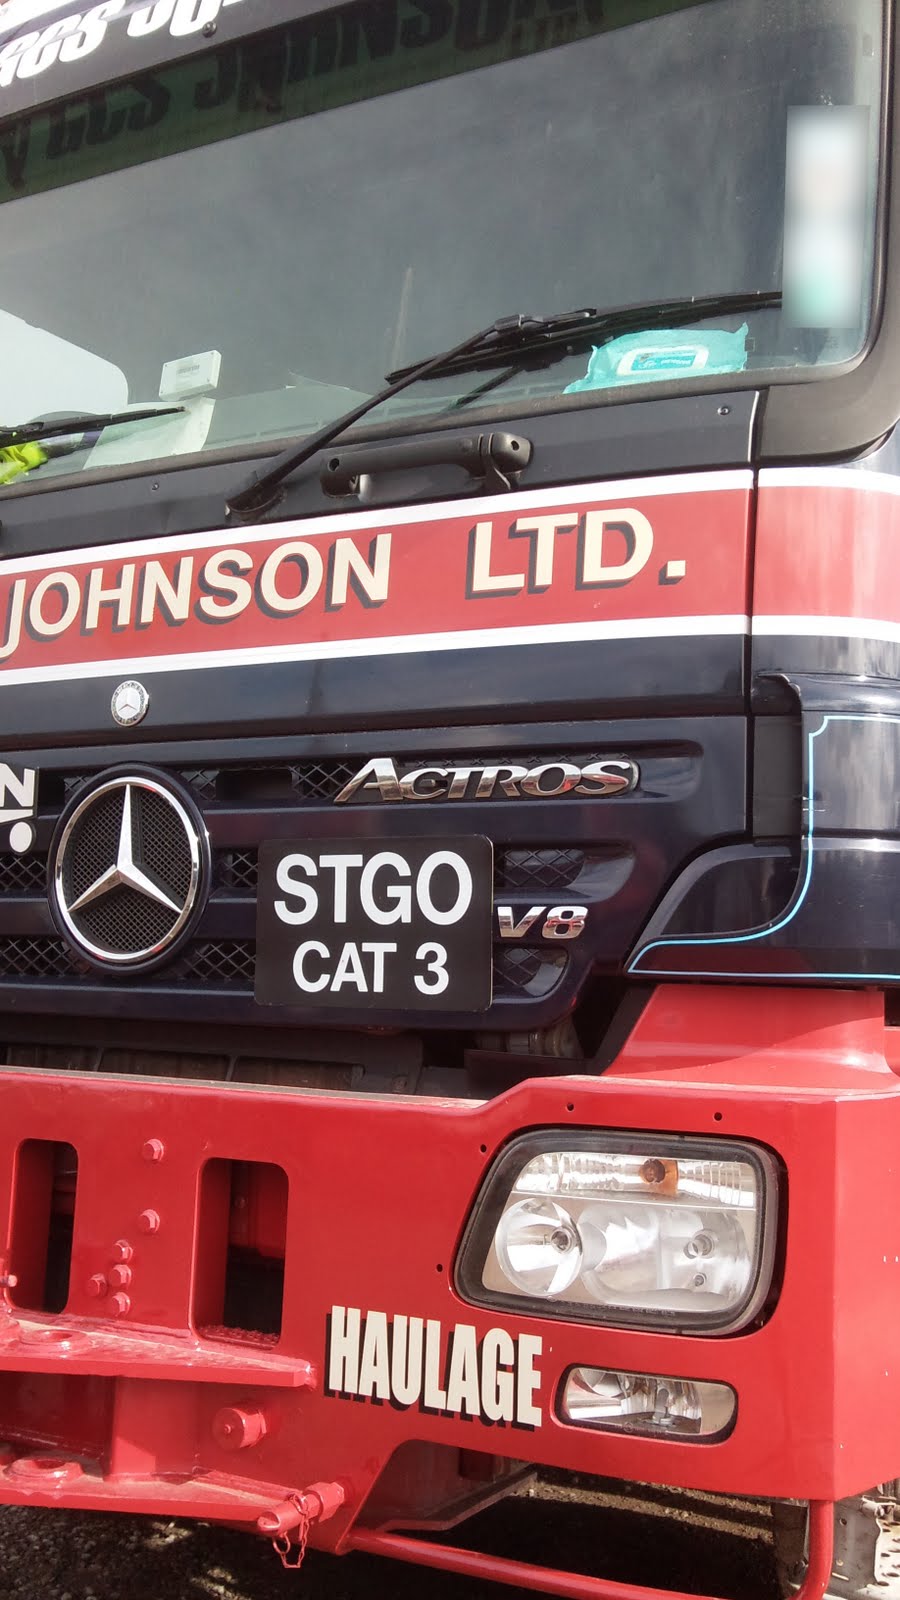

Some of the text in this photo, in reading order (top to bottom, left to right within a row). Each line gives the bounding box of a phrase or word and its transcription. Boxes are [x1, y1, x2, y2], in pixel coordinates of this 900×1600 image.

[0, 506, 687, 661] JOHNSON LTD.
[273, 850, 473, 927] STGO
[497, 905, 589, 940] V8
[292, 940, 450, 996] CAT 3
[325, 1304, 543, 1431] HAULAGE
